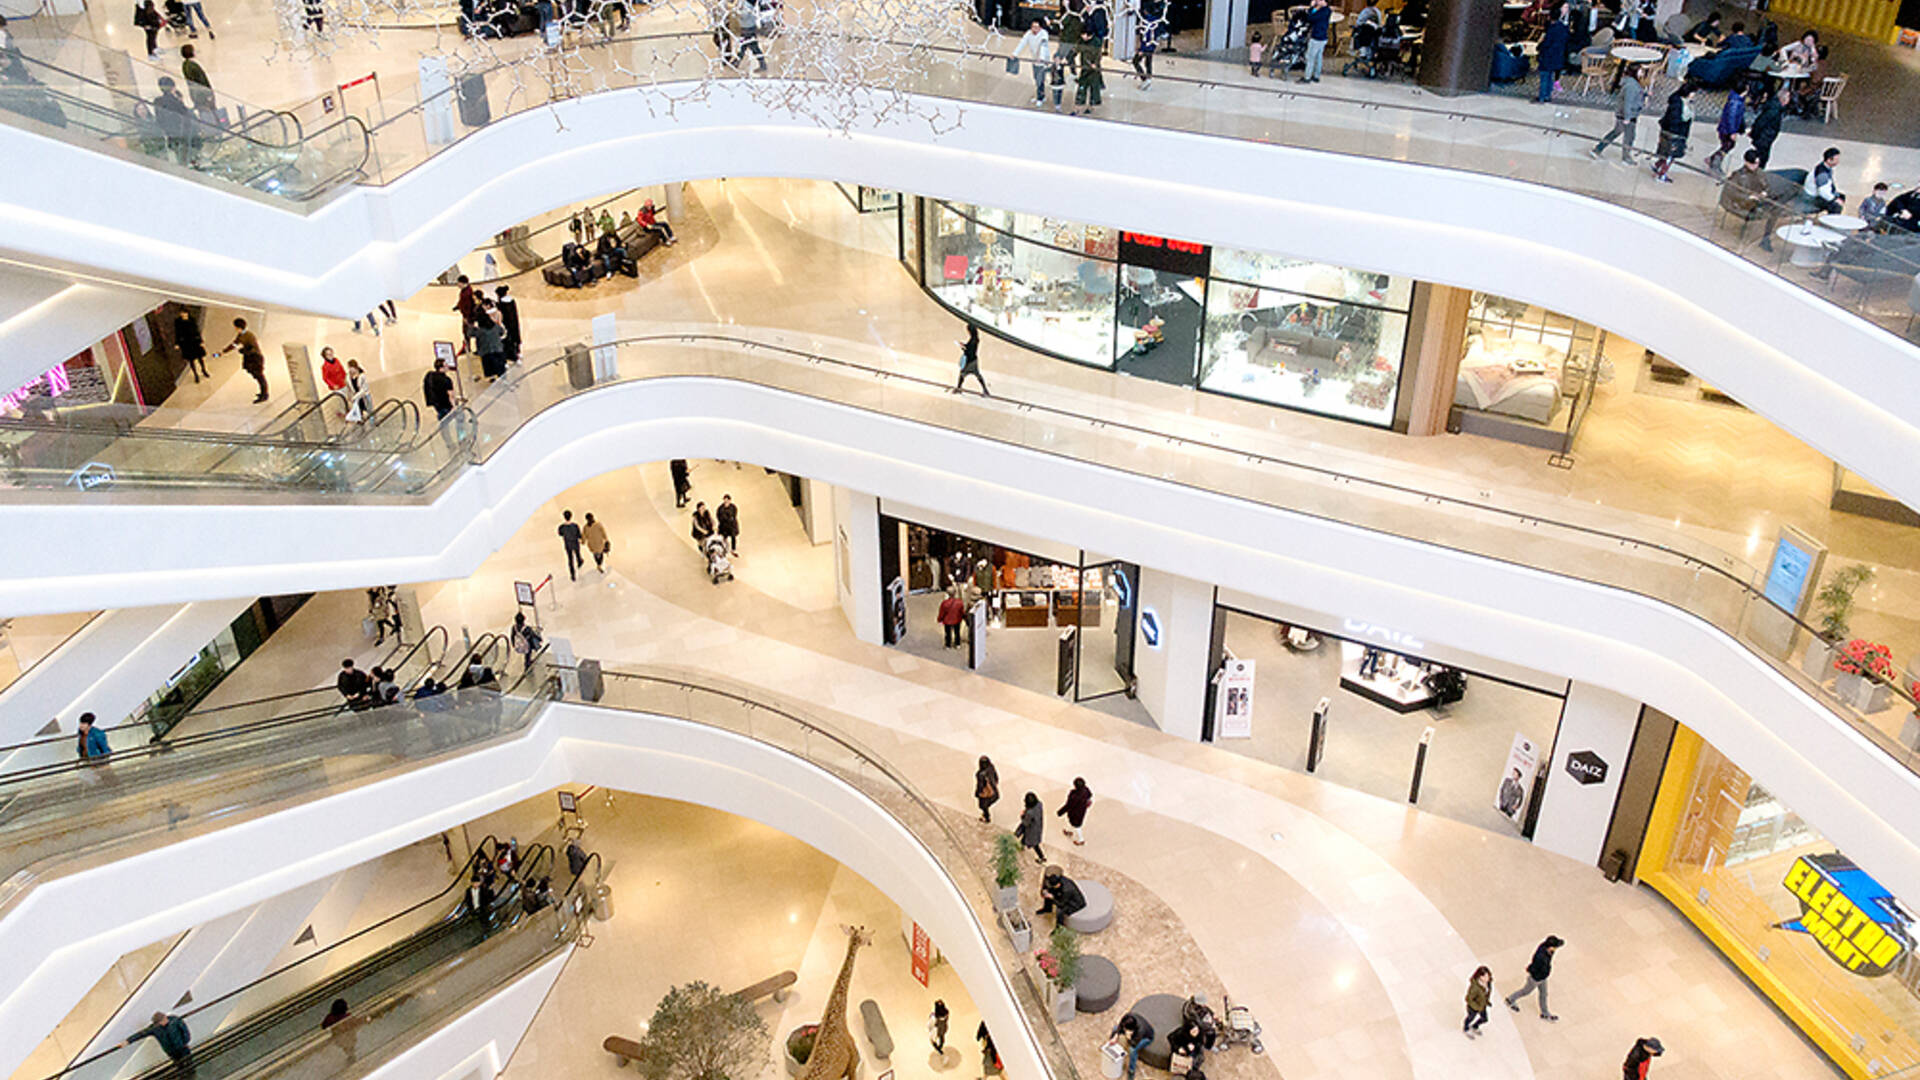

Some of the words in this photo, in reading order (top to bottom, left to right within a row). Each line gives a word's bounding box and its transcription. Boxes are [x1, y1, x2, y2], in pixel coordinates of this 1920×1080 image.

[1571, 760, 1603, 777] DAIZ
[1782, 856, 1902, 969] ELECTRO
[1800, 908, 1871, 971] MART
